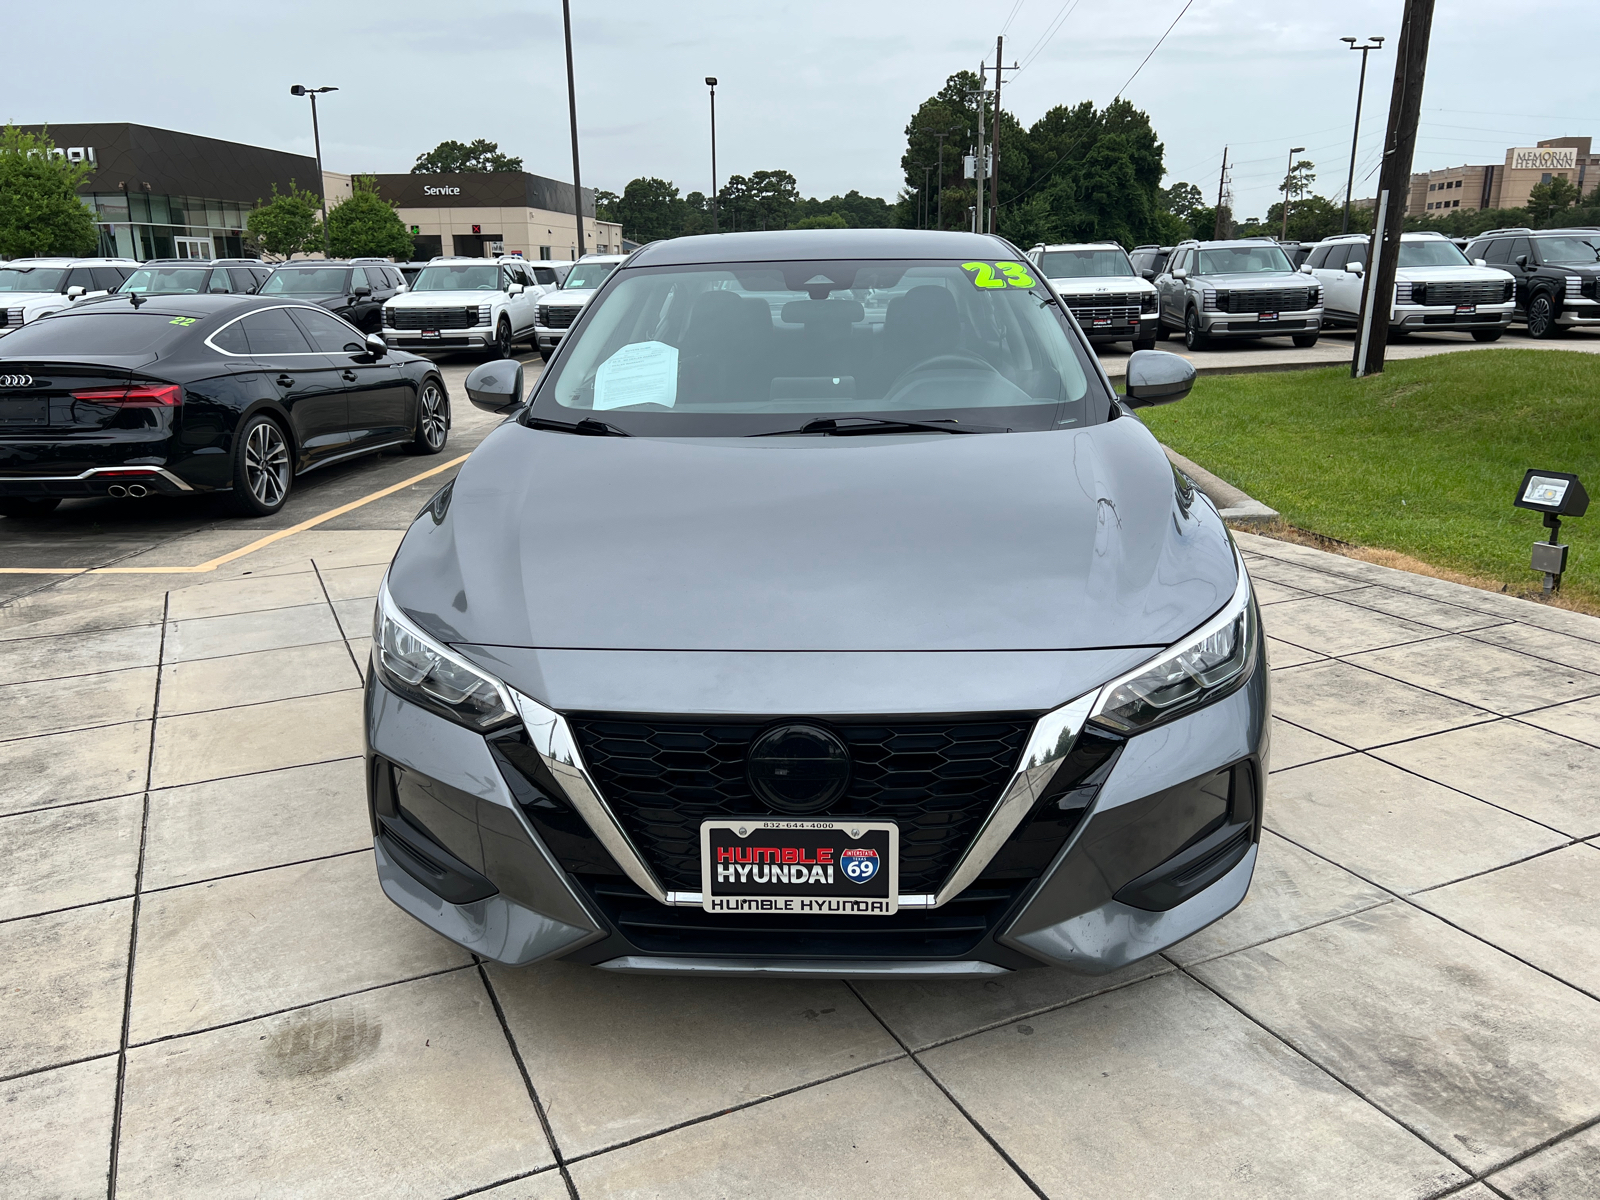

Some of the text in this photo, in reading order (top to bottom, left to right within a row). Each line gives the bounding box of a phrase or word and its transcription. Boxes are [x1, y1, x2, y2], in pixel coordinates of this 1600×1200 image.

[1517, 151, 1574, 160] MEMORIAL
[1515, 159, 1573, 168] HERMANN
[424, 185, 460, 195] Service
[961, 262, 1036, 288] 23
[169, 316, 196, 327] 22
[717, 847, 834, 864] HUMBLE
[717, 864, 834, 884] HYUNDAI
[847, 861, 874, 877] 69
[712, 899, 890, 912] HUMBLE HYUNDAI
